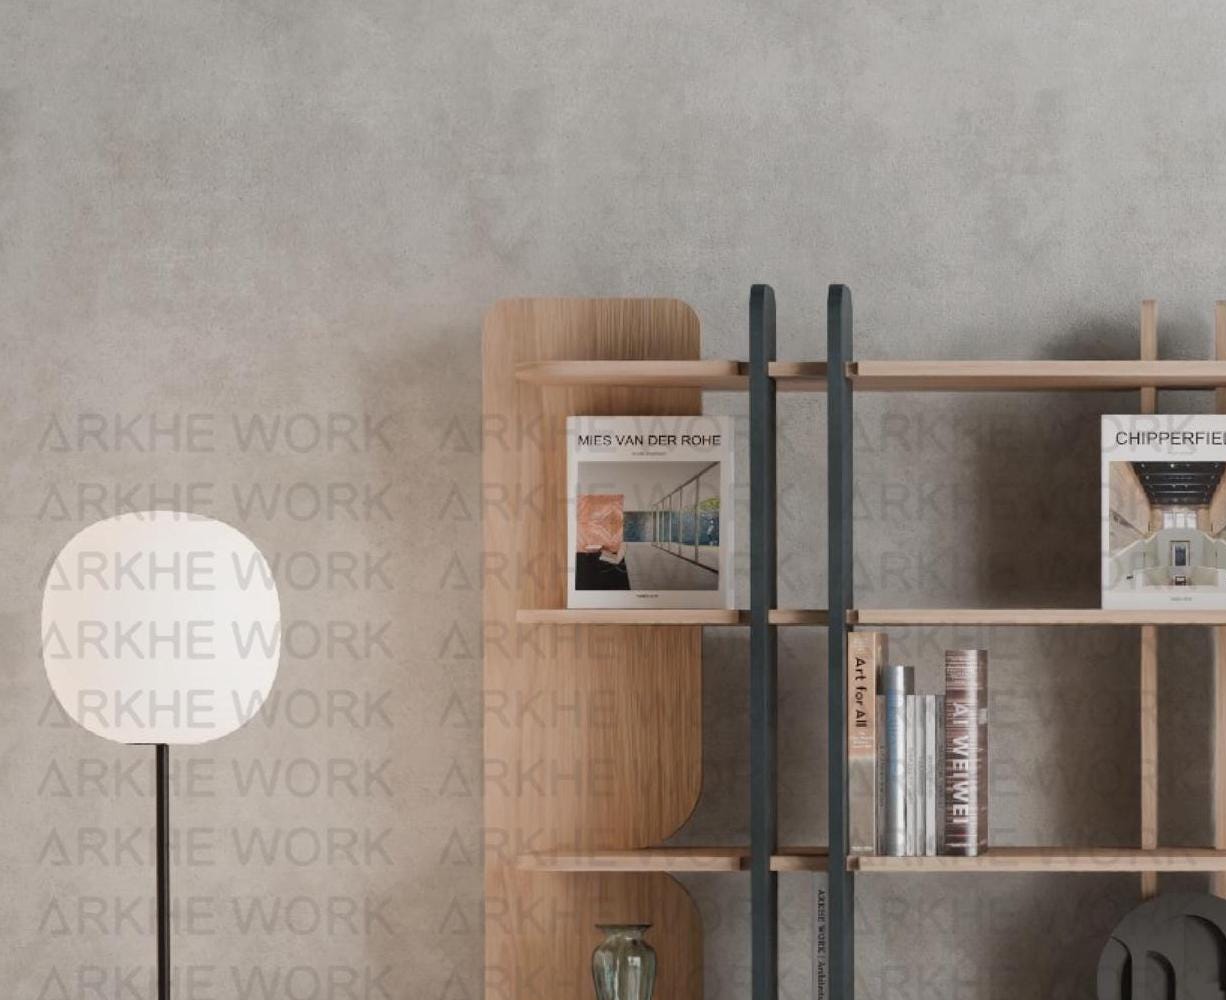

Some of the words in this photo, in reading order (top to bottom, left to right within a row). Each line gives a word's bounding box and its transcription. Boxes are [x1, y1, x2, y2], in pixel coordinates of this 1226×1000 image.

[577, 434, 612, 447] MIES
[614, 434, 644, 447] VAN
[648, 434, 677, 447] DER
[680, 434, 722, 447] ROHE
[855, 657, 867, 681] Art
[855, 685, 867, 706] for
[855, 710, 867, 728] All
[952, 702, 969, 725] AI
[952, 735, 969, 824] WEIWEI
